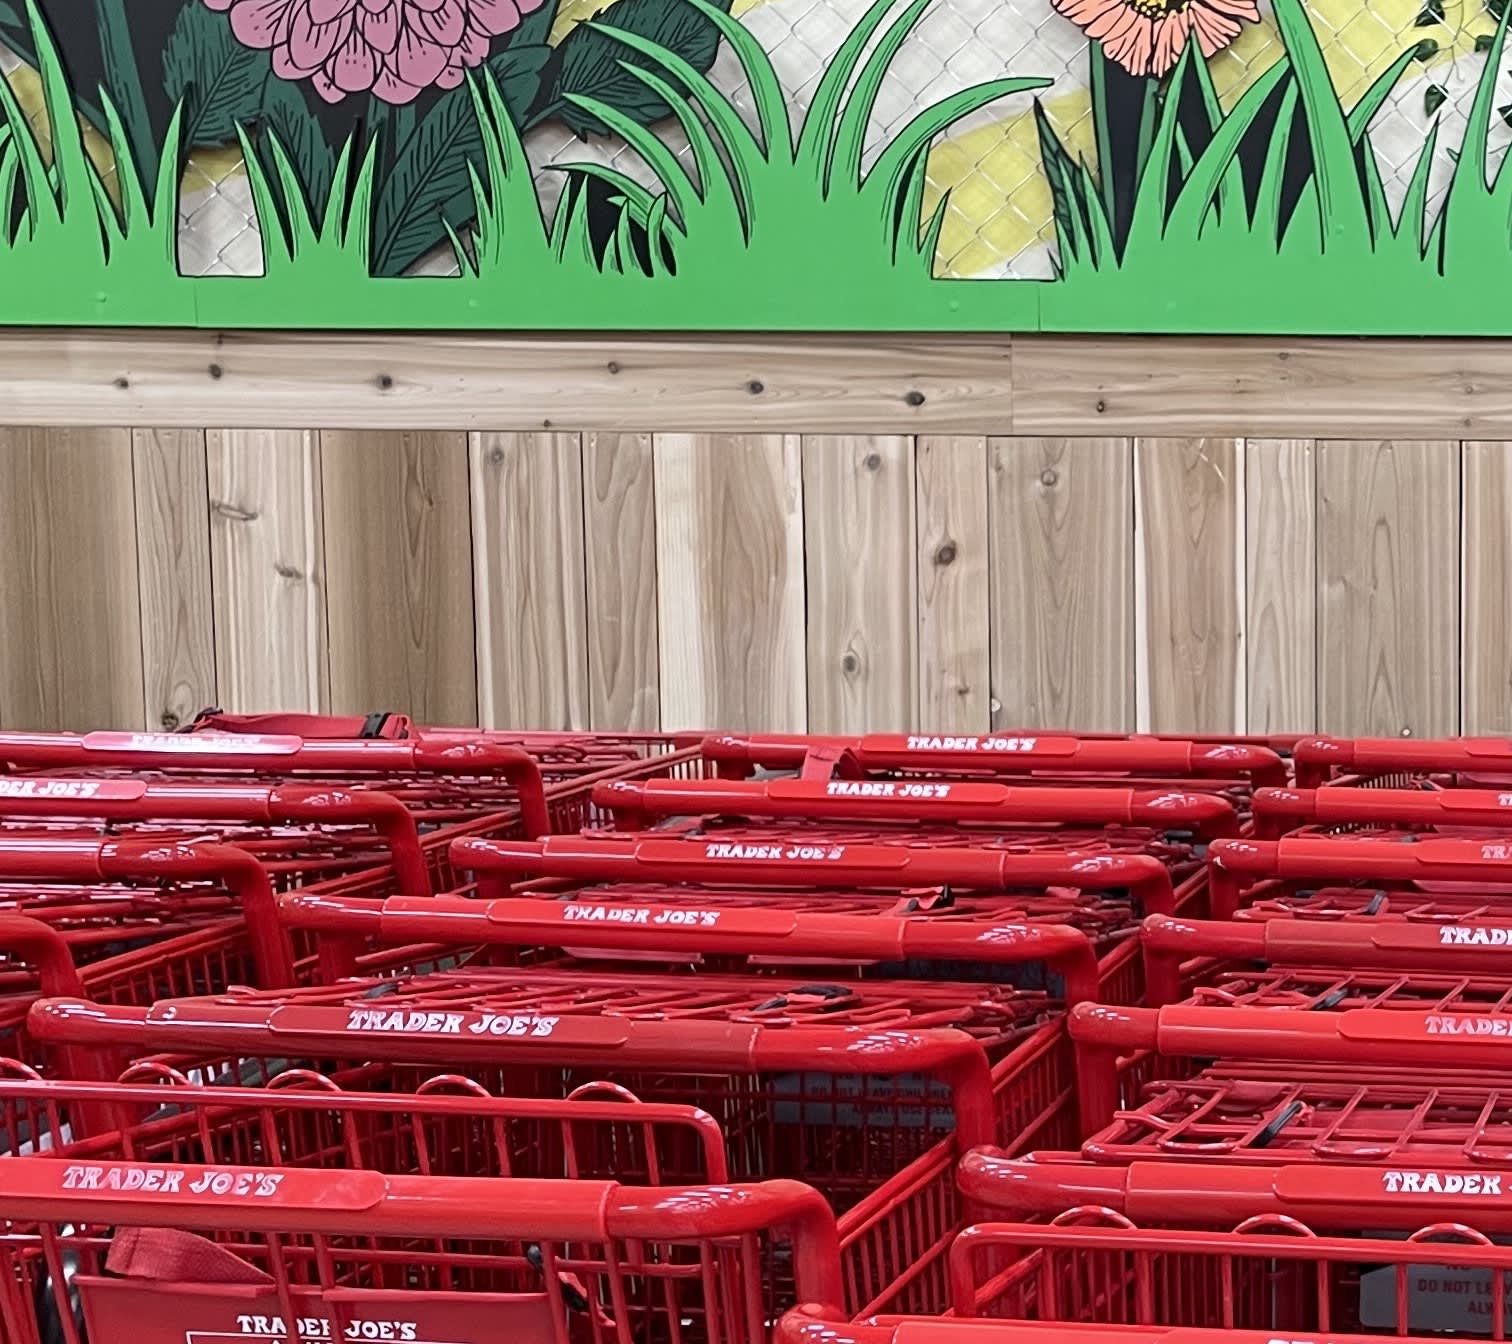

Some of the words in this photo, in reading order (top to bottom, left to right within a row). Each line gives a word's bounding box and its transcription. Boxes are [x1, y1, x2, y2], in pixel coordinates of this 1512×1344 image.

[906, 737, 977, 750] TRADER
[982, 738, 1036, 751] JOE'S
[38, 782, 99, 795] JOE'S
[827, 783, 895, 797] TRADER
[898, 784, 950, 798] JOE'S
[705, 843, 783, 858] TRADER
[786, 844, 845, 859] JOE'S
[563, 905, 651, 923] TRADER
[654, 909, 720, 926] JOE'S
[346, 1009, 463, 1034] TRADER
[468, 1013, 558, 1037] JOE'S
[62, 1166, 183, 1191] TRADER
[189, 1172, 284, 1197] JOE'S
[1382, 1171, 1502, 1195] TRADER
[344, 1320, 417, 1340] JOE'S
